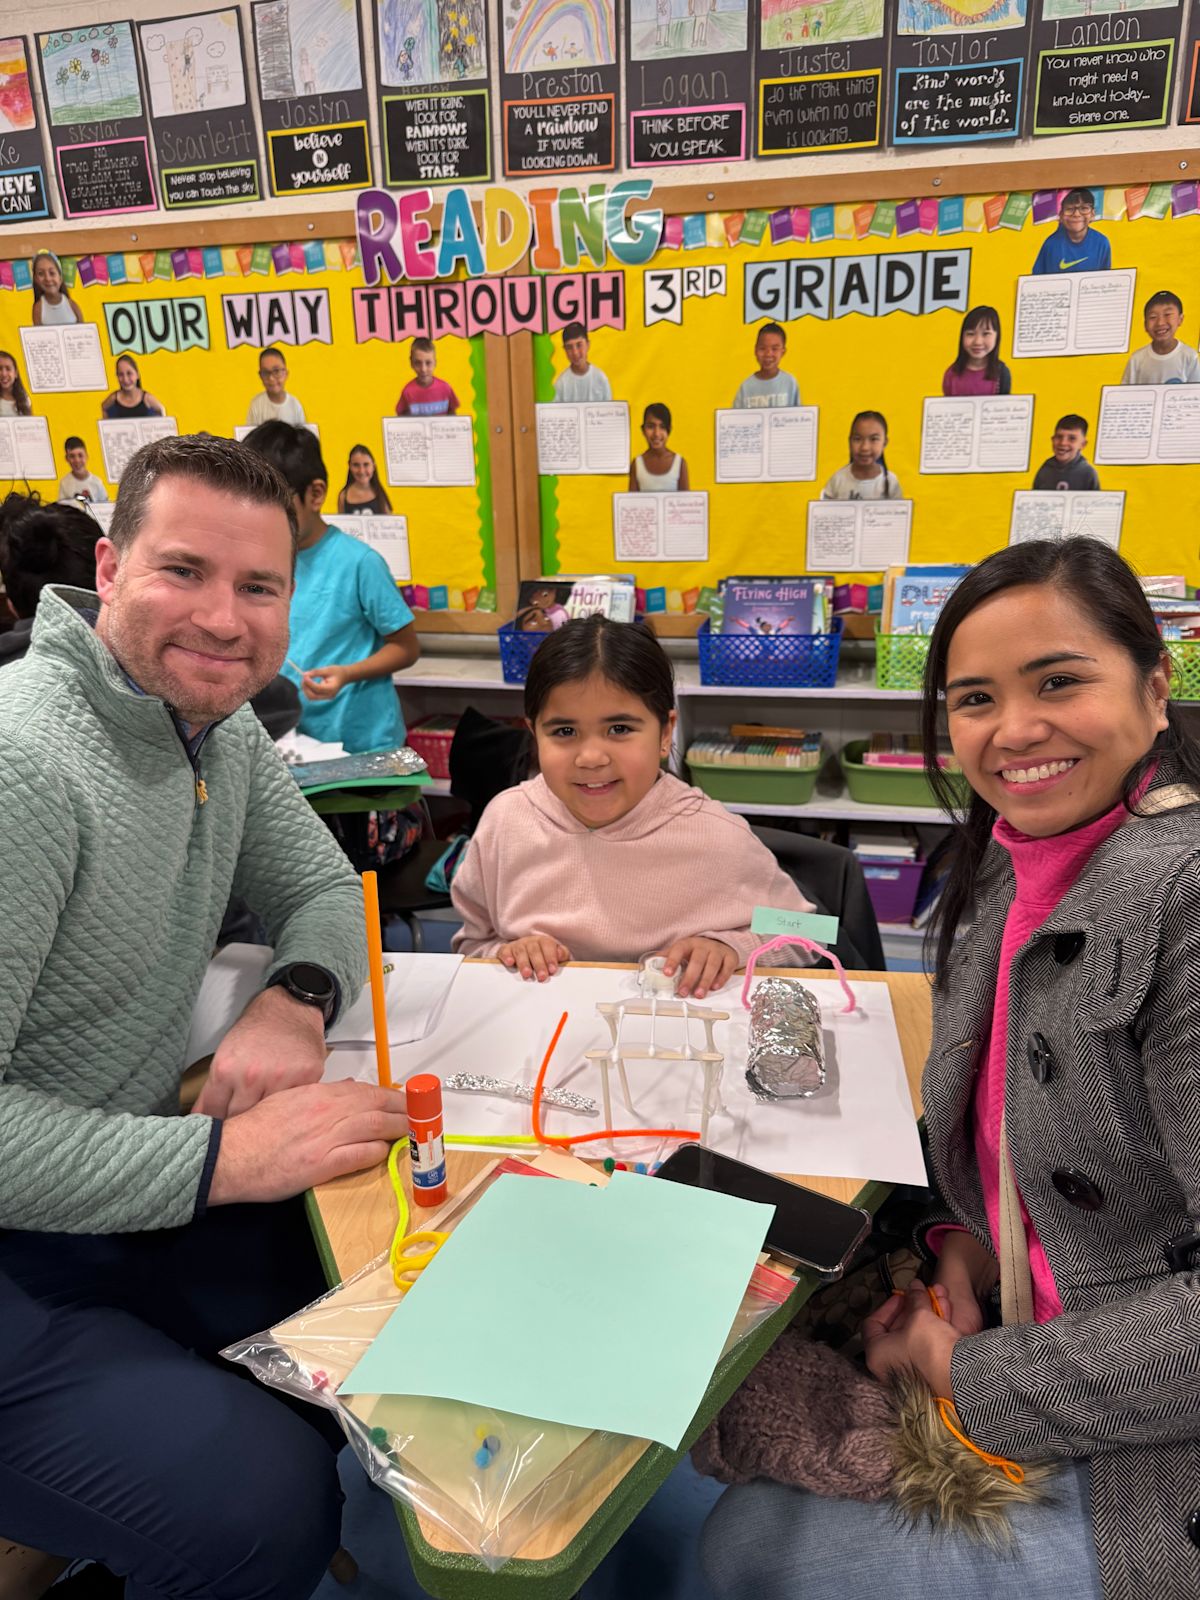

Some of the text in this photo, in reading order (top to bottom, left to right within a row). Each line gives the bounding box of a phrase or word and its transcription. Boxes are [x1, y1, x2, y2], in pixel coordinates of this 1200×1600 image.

[1053, 14, 1140, 49] Landon
[912, 34, 997, 66] Taylor
[1046, 48, 1166, 70] You never know who
[779, 44, 850, 77] Justej
[522, 68, 603, 99] Preston
[912, 67, 1005, 91] Kind words
[1102, 68, 1128, 83] need
[1131, 70, 1139, 81] a
[402, 84, 449, 95] Harlow
[641, 65, 729, 107] Logan
[789, 84, 807, 101] the
[811, 81, 840, 99] right
[846, 77, 874, 95] thing
[430, 97, 438, 111] IT
[904, 89, 1012, 111] are the music
[1052, 92, 1075, 107] kind
[1075, 89, 1107, 105] word
[277, 96, 350, 128] Joslyn
[414, 110, 457, 125] LOOK FOR
[546, 104, 580, 117] NEVER
[581, 101, 608, 115] FIND
[765, 100, 876, 126] even when no one
[1068, 109, 1130, 124] share one.
[405, 122, 467, 139] RAINBOWS
[524, 116, 598, 136] A rainbow
[641, 114, 730, 135] THINK BEFORE
[900, 108, 1010, 135] of the world.
[161, 119, 251, 163] Scarlett
[293, 133, 342, 151] believe
[537, 139, 549, 152] IF
[649, 138, 727, 158] YOU SPEAK
[786, 131, 797, 147] is
[92, 156, 139, 171] FLOWERS
[416, 150, 460, 166] LOOK FOR
[521, 155, 565, 169] LOOKING
[291, 162, 351, 188] yourself
[420, 164, 459, 178] STARS.
[356, 179, 663, 287] READING
[112, 302, 204, 345] OUR
[226, 296, 322, 338] WAY
[360, 276, 620, 333] THROUGH
[751, 256, 960, 311] GRADE
[573, 587, 608, 606] Hair
[732, 586, 807, 601] FLYING HIGH
[777, 917, 802, 928] Start
